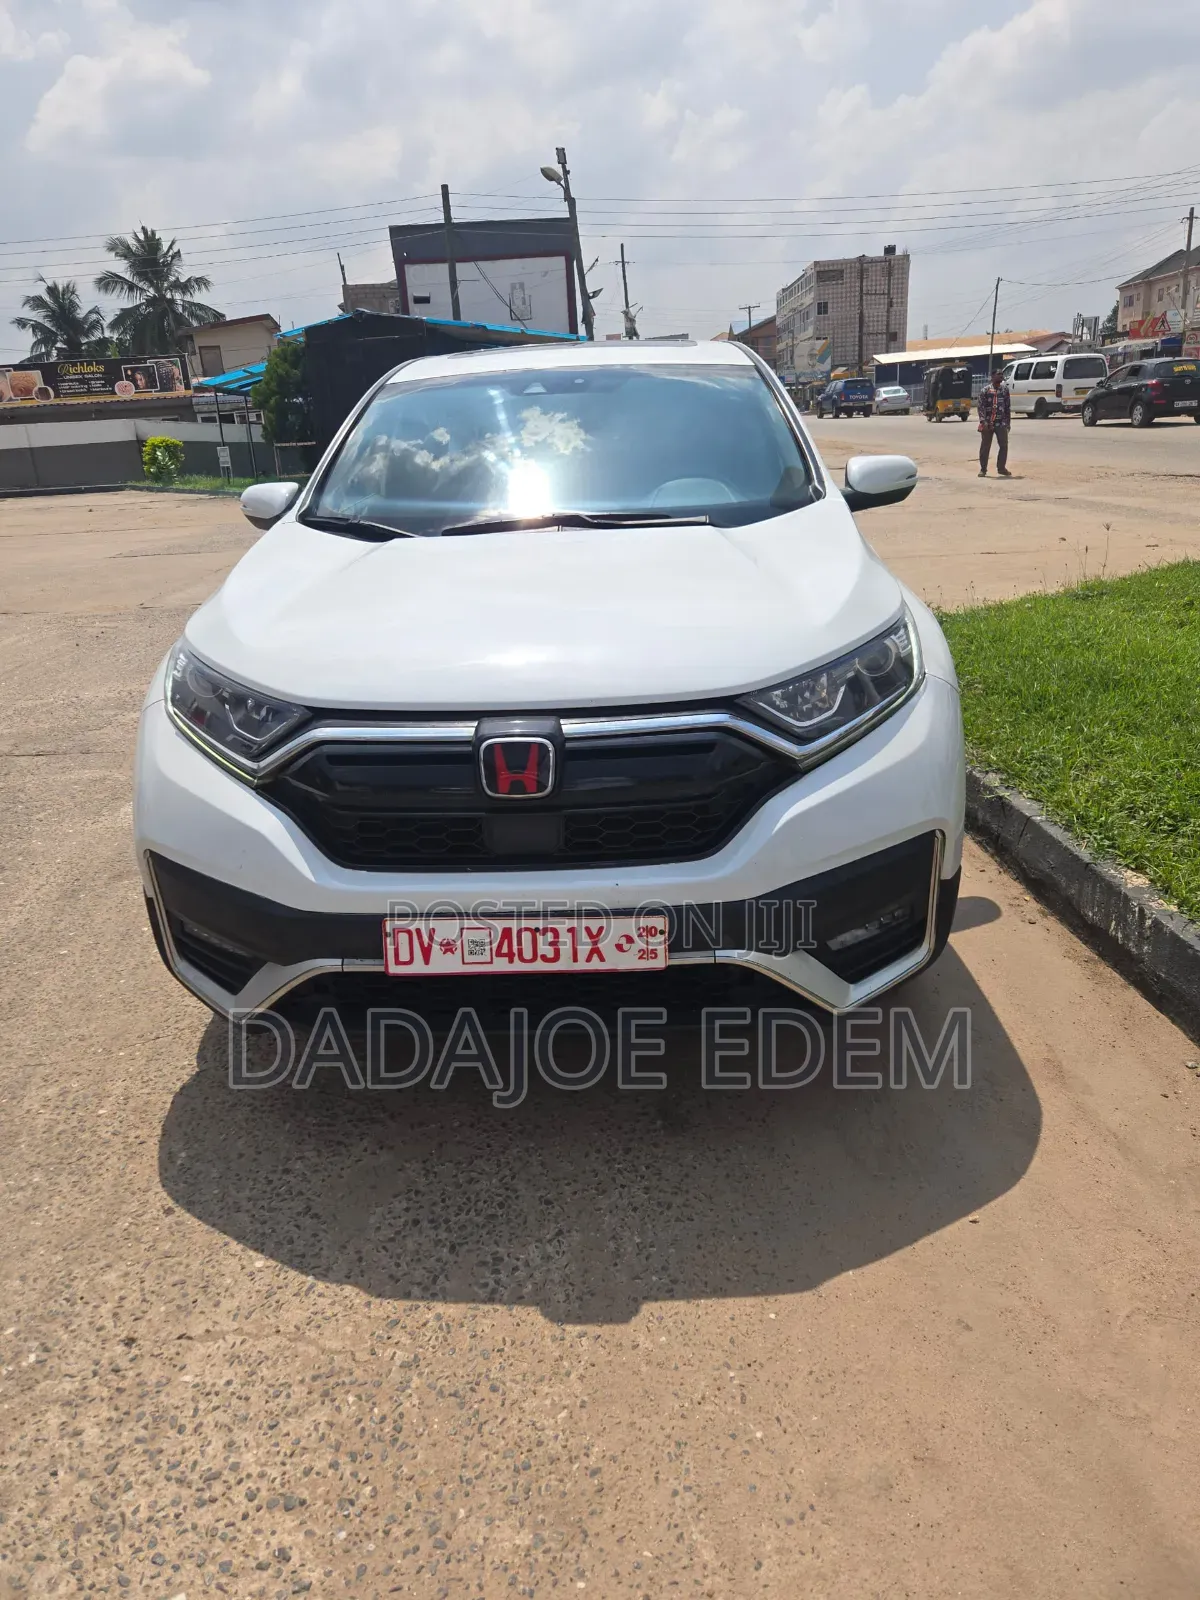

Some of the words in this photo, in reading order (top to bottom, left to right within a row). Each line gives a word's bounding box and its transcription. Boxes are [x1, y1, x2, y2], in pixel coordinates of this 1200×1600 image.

[57, 361, 105, 375] Richloks
[393, 927, 436, 966] DV
[495, 926, 606, 964] 4031X
